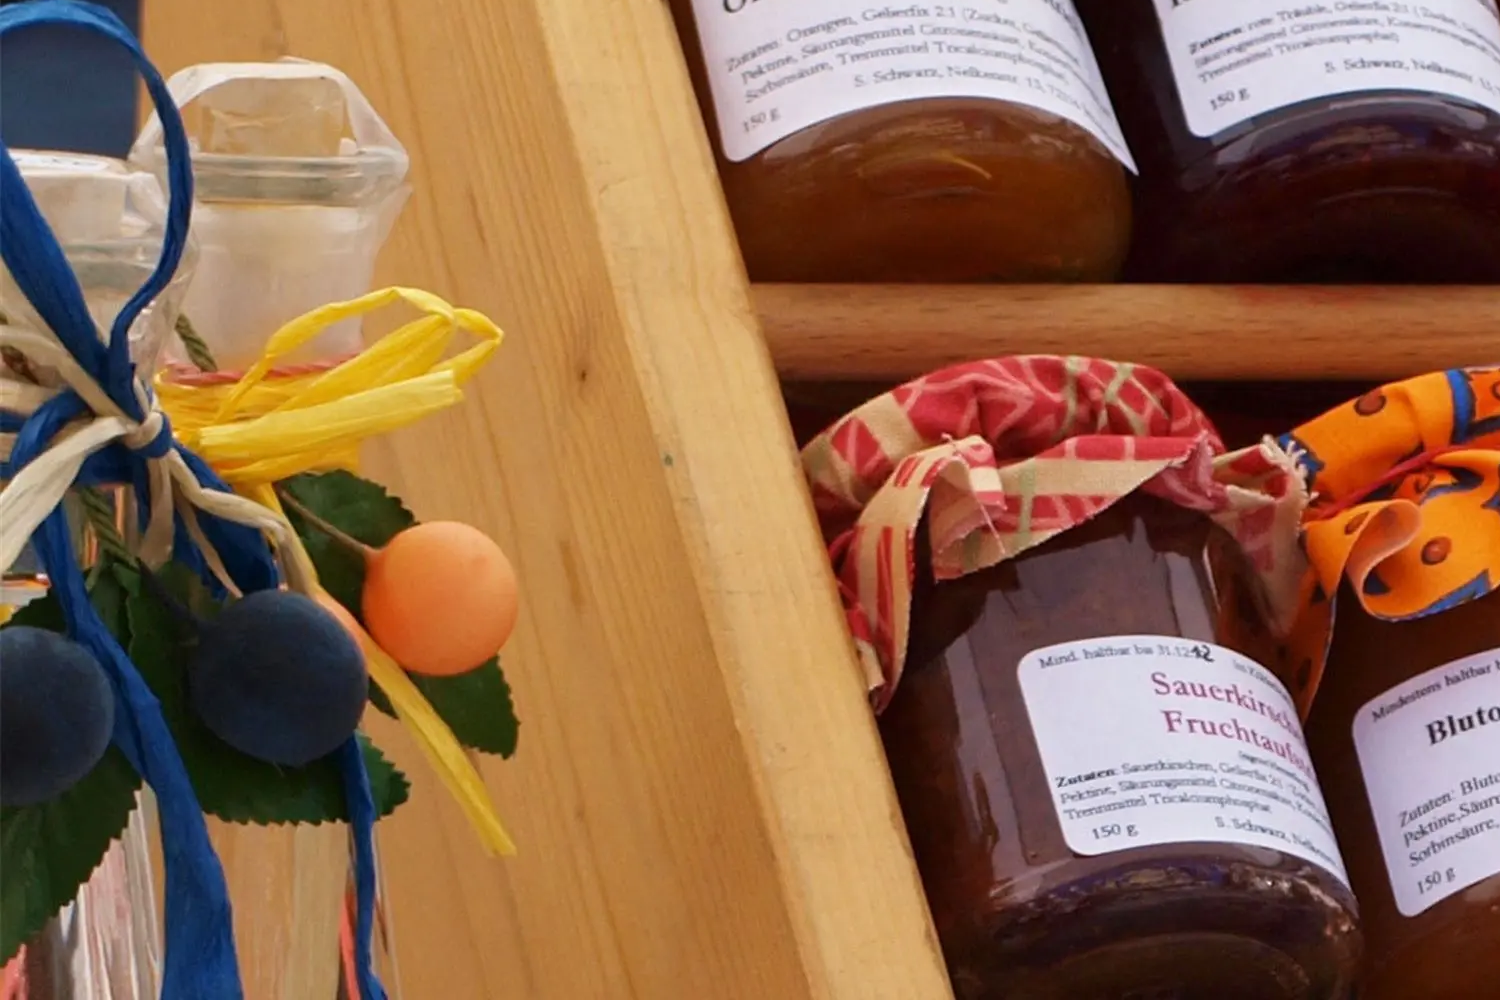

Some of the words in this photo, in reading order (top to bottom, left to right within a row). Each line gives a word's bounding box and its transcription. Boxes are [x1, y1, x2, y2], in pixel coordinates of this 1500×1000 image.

[1372, 680, 1443, 724] Mindestens
[1444, 664, 1493, 688] haltbar
[1398, 789, 1456, 829] Zutaten:
[1091, 822, 1121, 840] 150
[1127, 823, 1140, 837] g
[1408, 816, 1500, 868] Sorbinsäure,
[1416, 870, 1443, 896] 150
[1443, 865, 1456, 882] g
